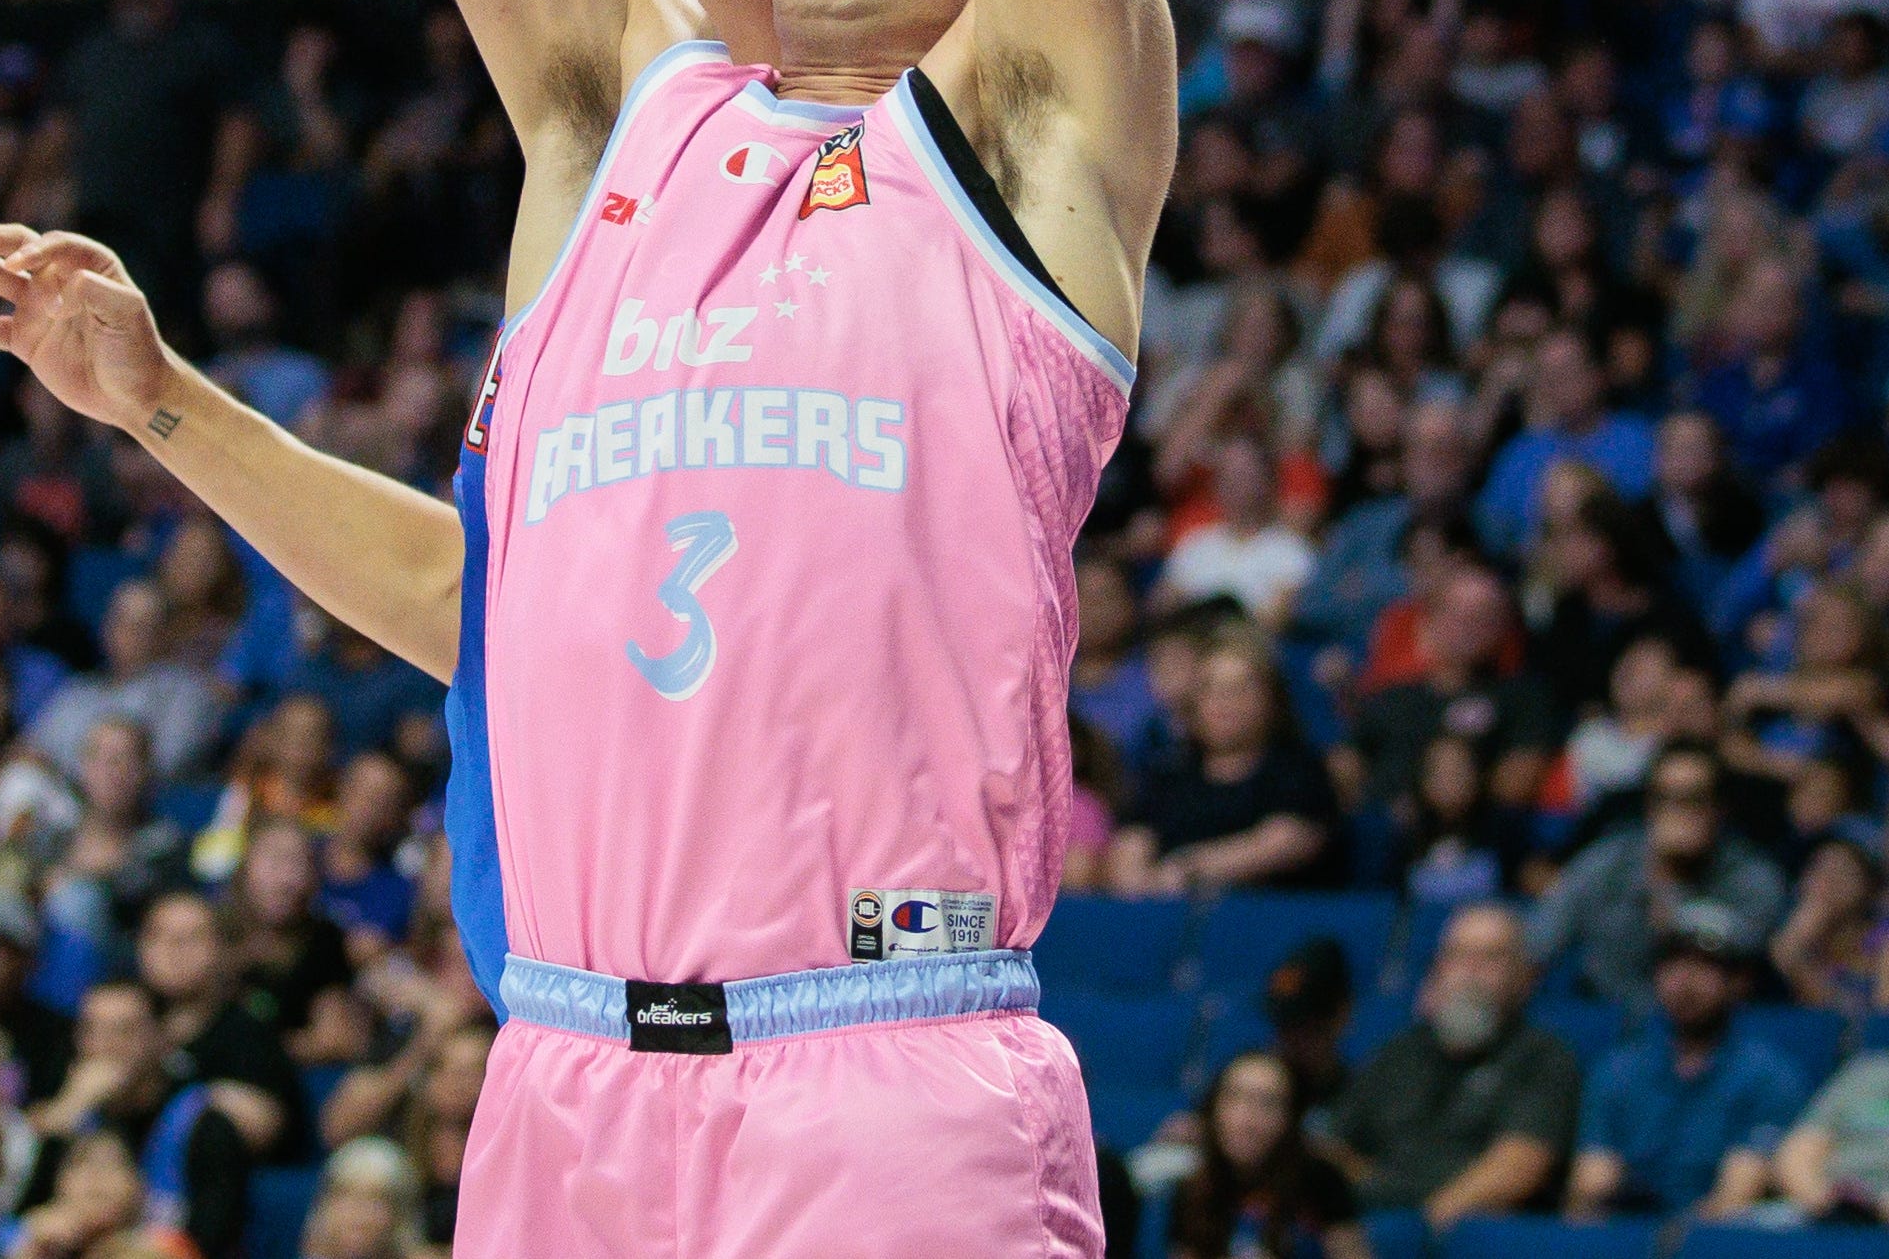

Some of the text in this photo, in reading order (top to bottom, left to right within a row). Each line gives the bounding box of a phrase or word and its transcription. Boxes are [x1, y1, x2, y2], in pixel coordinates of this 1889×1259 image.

[813, 180, 851, 197] ACK'S
[602, 298, 759, 376] bnz
[625, 510, 739, 702] 3
[947, 914, 986, 929] SINCE
[952, 929, 980, 943] 1919
[637, 1008, 713, 1025] breakers
